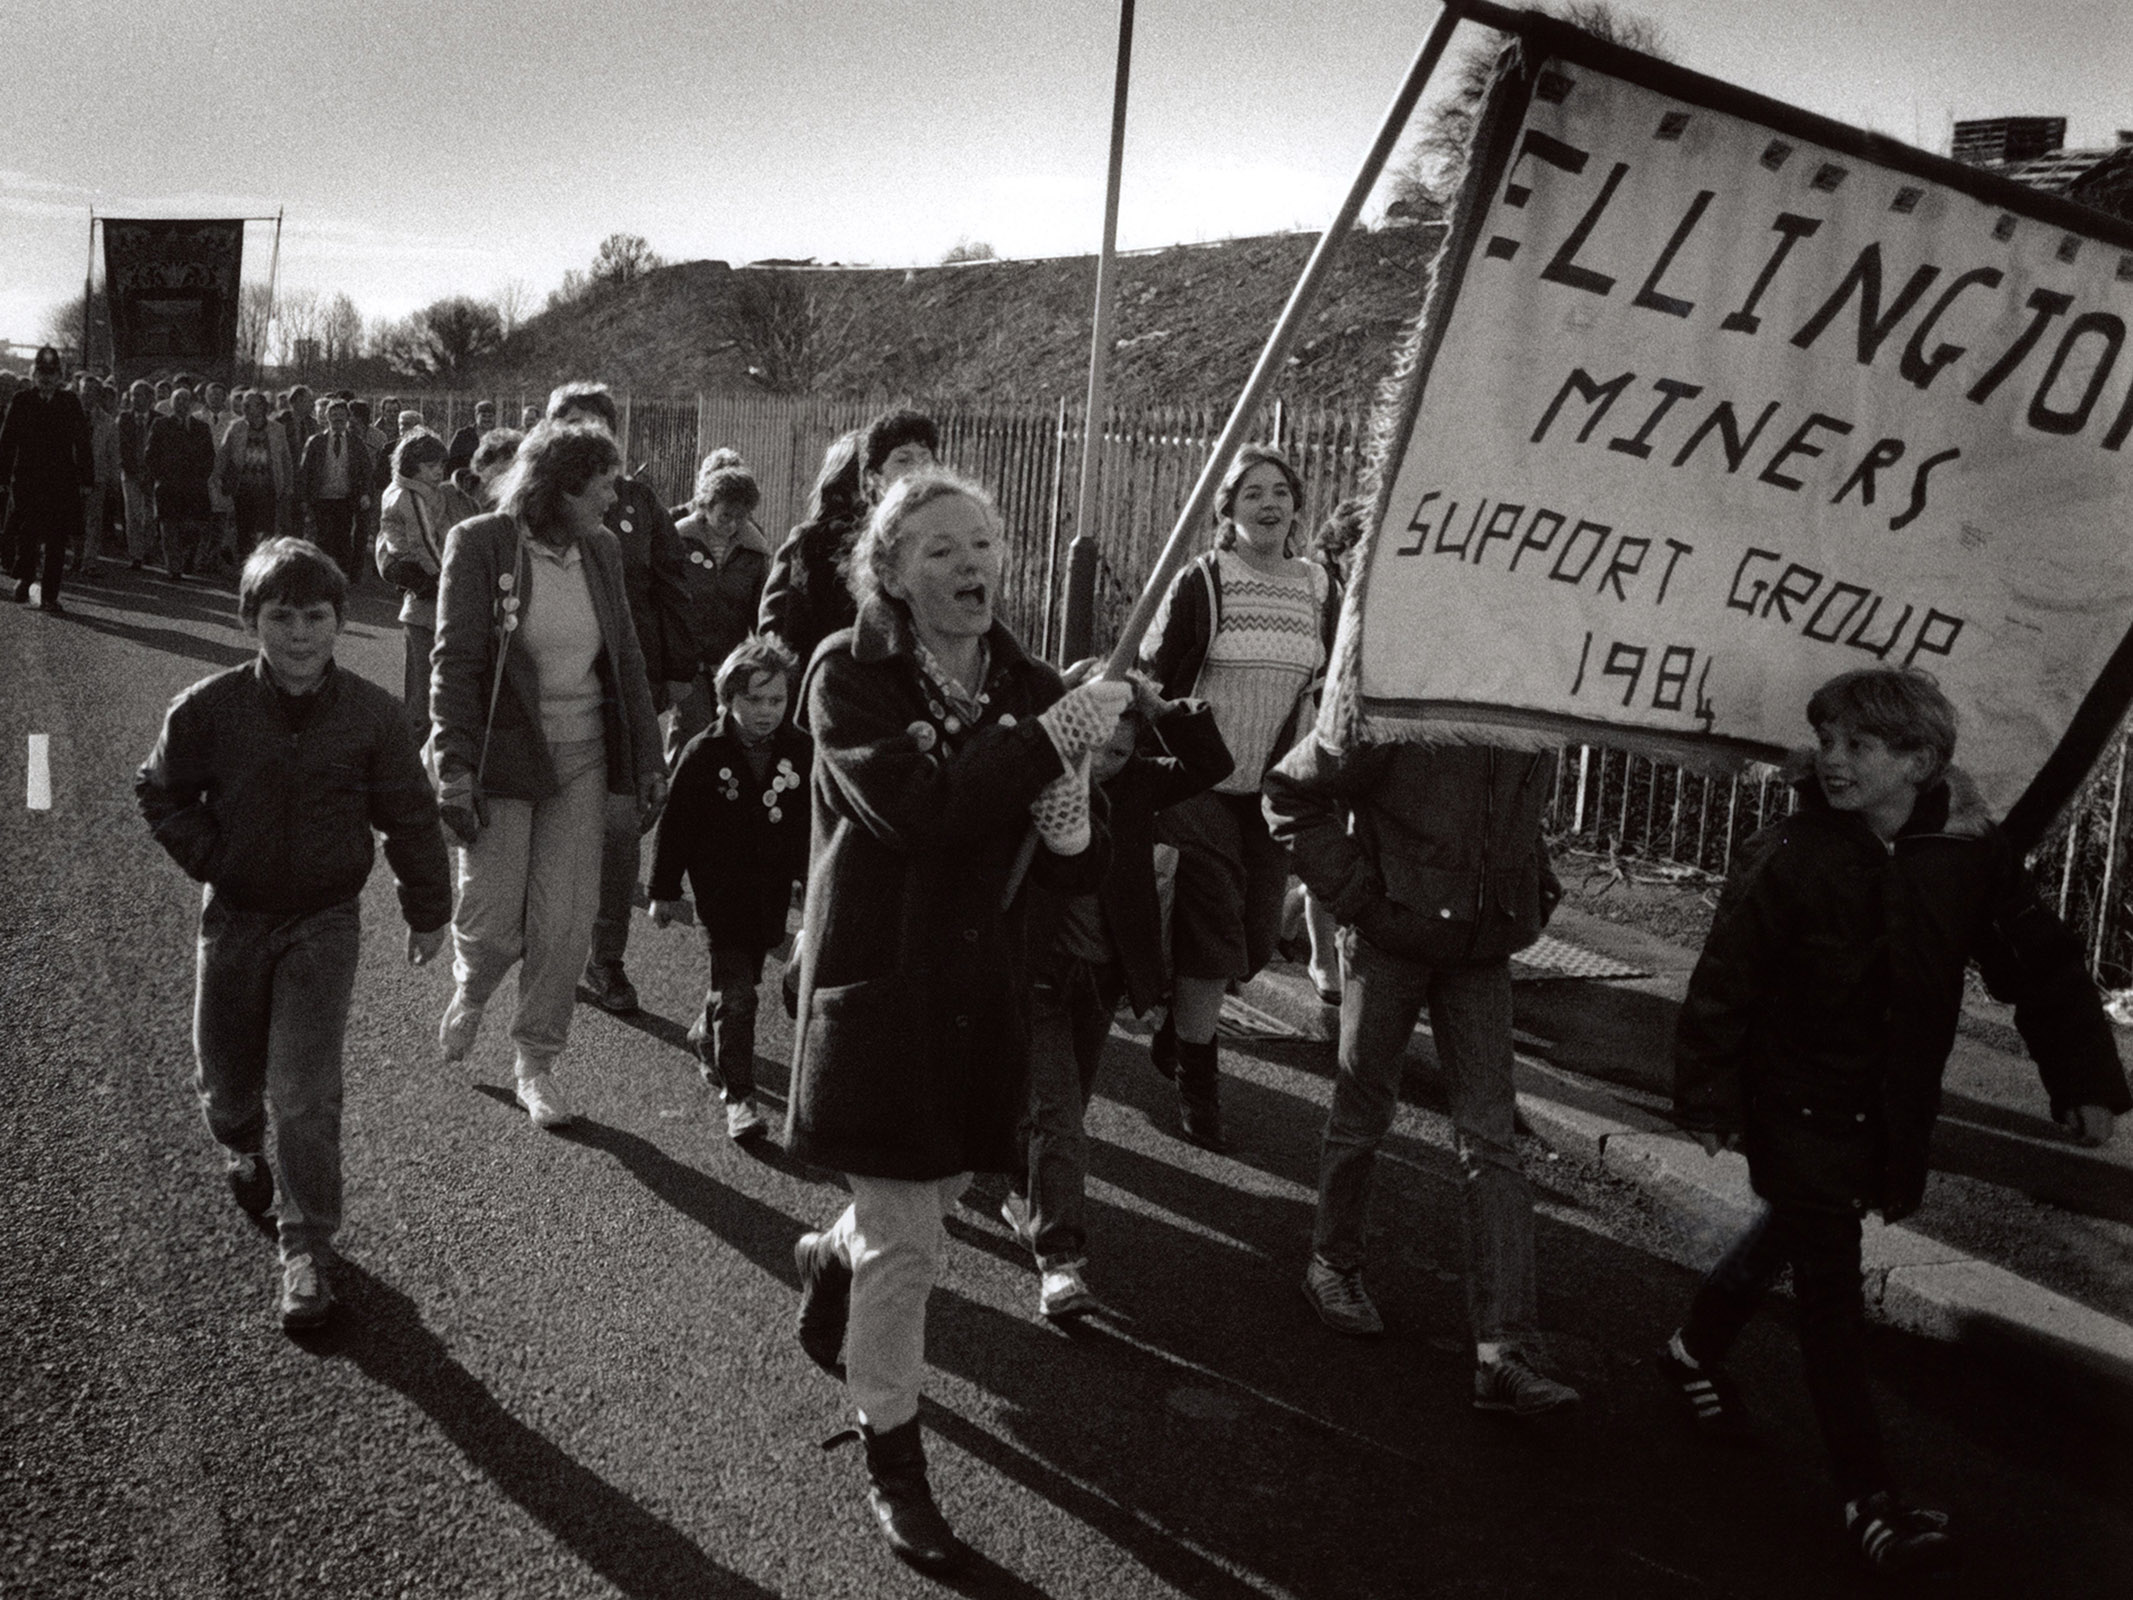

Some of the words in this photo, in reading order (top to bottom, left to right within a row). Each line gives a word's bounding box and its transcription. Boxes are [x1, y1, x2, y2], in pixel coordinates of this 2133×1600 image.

[1485, 129, 2133, 451] ELLINGTO
[1530, 367, 1961, 531] MINERS
[1397, 491, 1693, 605] SUPPORT
[1726, 547, 1965, 665] GROUP
[1570, 631, 1715, 733] 1984
